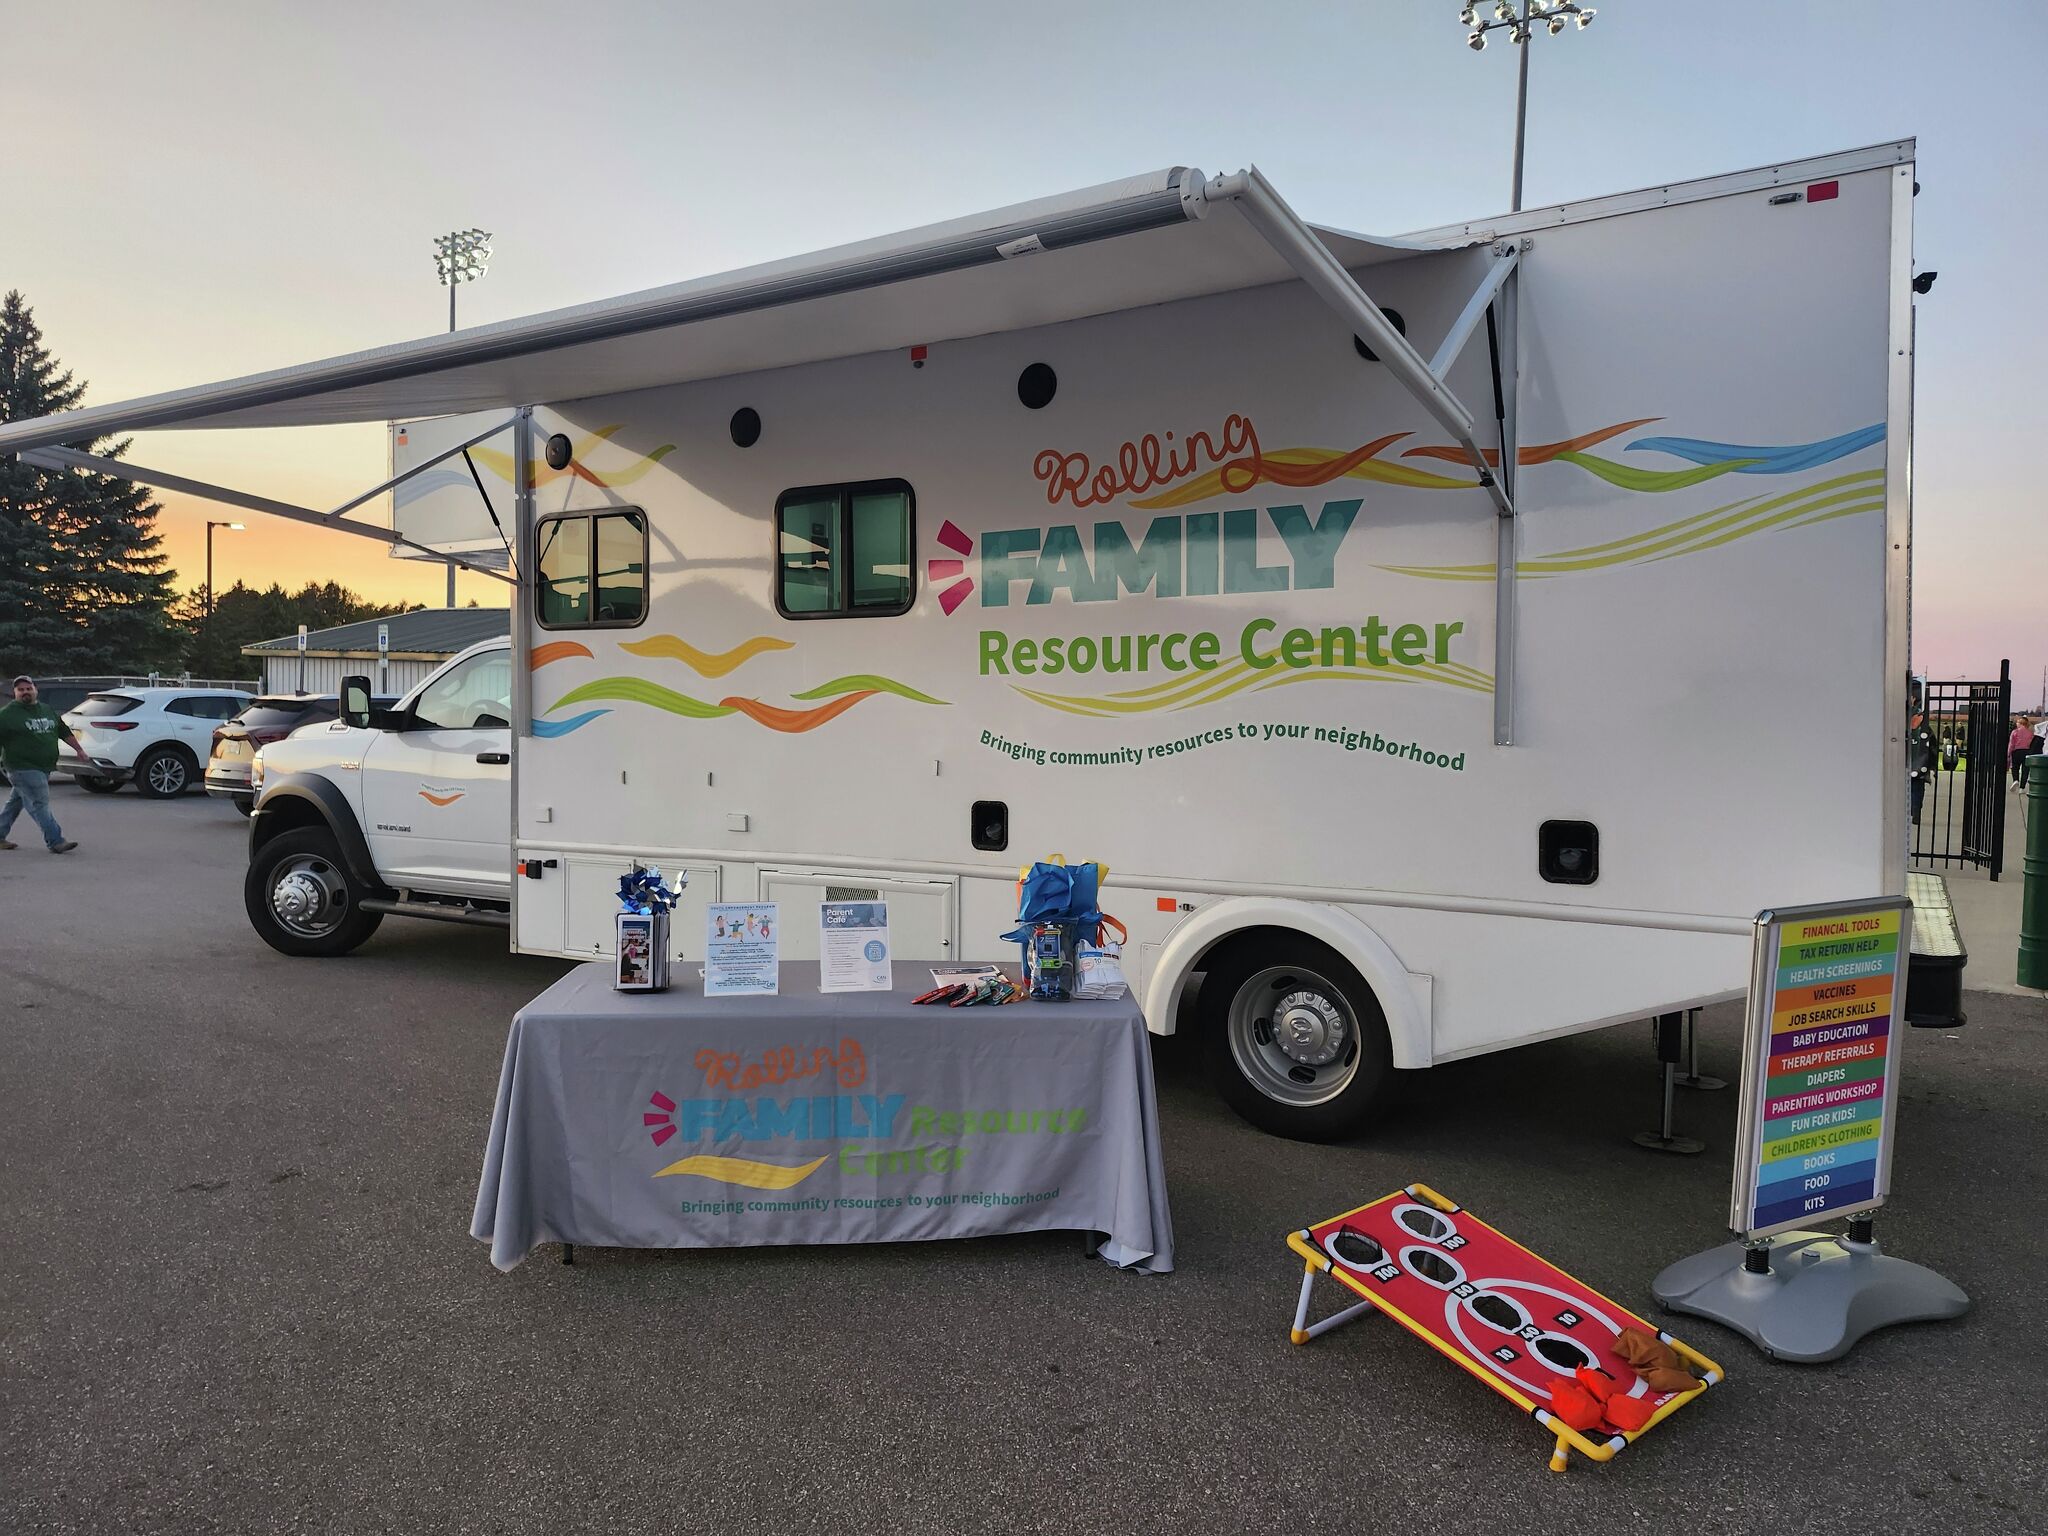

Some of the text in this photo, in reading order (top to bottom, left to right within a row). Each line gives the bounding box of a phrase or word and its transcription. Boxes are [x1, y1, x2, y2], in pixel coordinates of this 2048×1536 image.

[1033, 413, 1261, 508] Rolling
[980, 498, 1364, 608] FAMILY
[979, 615, 1464, 676] Resource Center
[979, 722, 1466, 772] Bringing community resources to your neighborhood
[826, 908, 853, 916] Parent
[827, 916, 846, 924] Café
[1802, 918, 1880, 939] FINANCIAL TOOLS
[1800, 939, 1880, 960] TAX RETURN HELP
[1790, 959, 1883, 984] HEALTH SCREENINGS
[1813, 984, 1856, 1001] VACCINES
[1788, 1002, 1876, 1027] JOB SEARCH SKILLS
[1792, 1023, 1869, 1048] BABY EDUCATION
[695, 1038, 867, 1090] Rolling
[1781, 1043, 1875, 1071] THERAPY REFERRALS
[1807, 1068, 1846, 1086] DIAPERS
[1772, 1083, 1877, 1114] PARENTING WORKSHOP
[682, 1094, 1088, 1142] FAMILY Resource
[1791, 1107, 1856, 1132] FUN FOR KIDS!
[1771, 1124, 1872, 1157] CHILDREN'S CLOTHING
[838, 1144, 972, 1176] Center
[1804, 1153, 1836, 1170] BOOKS
[1804, 1174, 1830, 1191] FOOD
[682, 1187, 1060, 1216] Bringing community resources to your neighborhood
[1804, 1196, 1825, 1211] KITS
[1442, 1235, 1466, 1250] 100
[1375, 1265, 1400, 1281] 100
[1454, 1284, 1474, 1297] 50
[1558, 1313, 1577, 1326] 10
[1520, 1325, 1540, 1339] 40
[1495, 1348, 1515, 1361] 10
